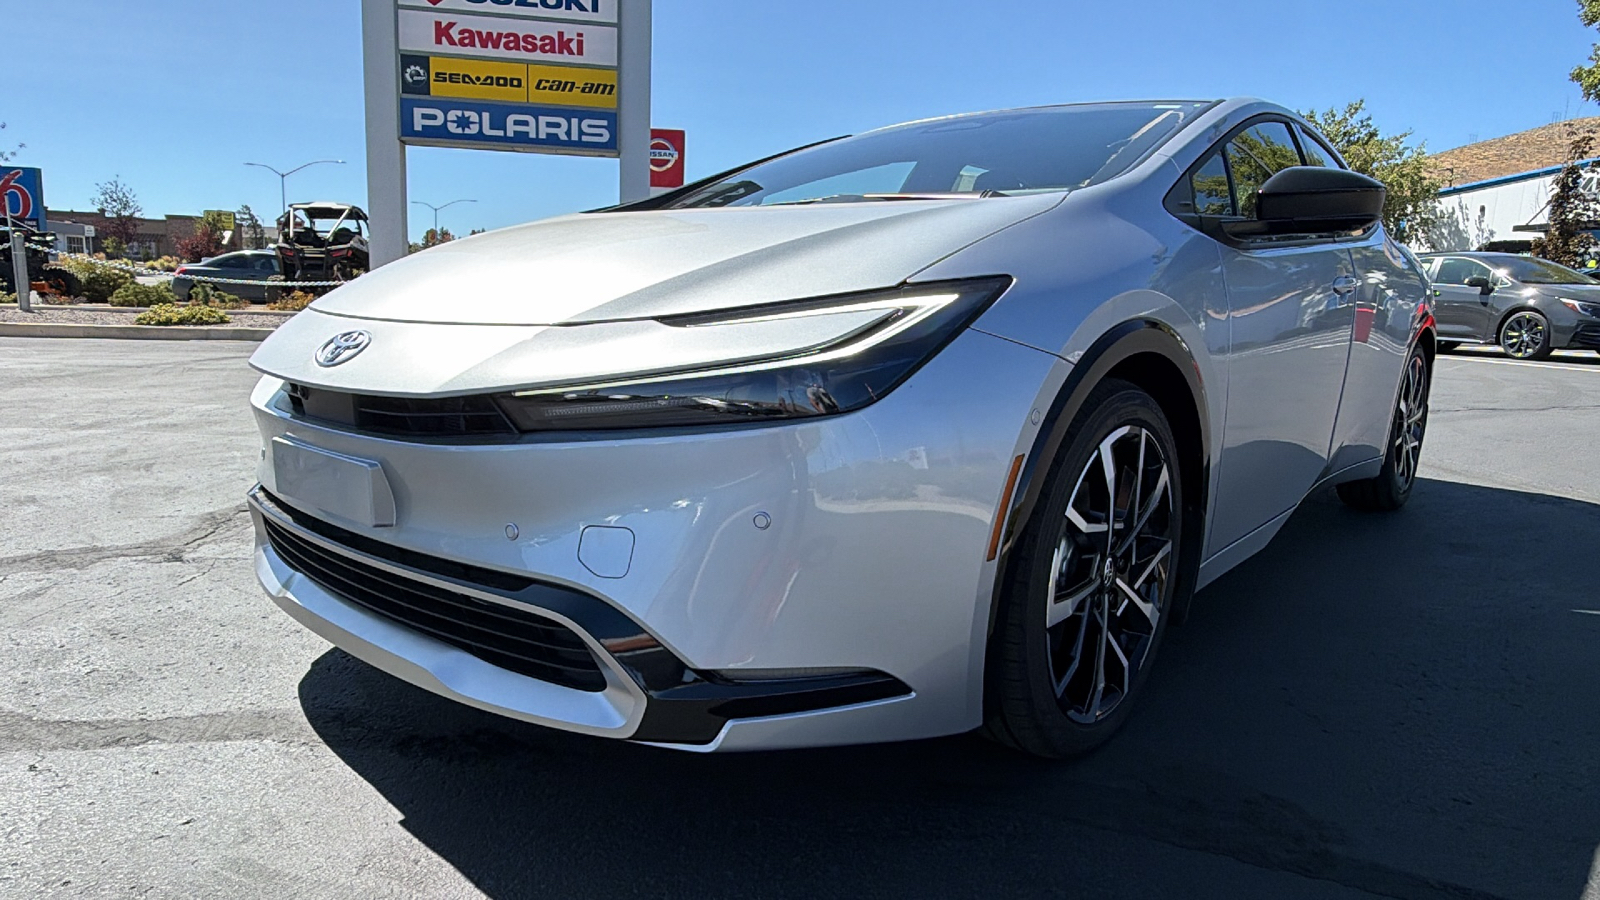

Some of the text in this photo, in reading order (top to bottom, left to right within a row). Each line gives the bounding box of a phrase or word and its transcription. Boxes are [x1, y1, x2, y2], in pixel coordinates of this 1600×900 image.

[434, 21, 584, 56] Kawasaki
[535, 79, 615, 95] can-am
[413, 107, 611, 143] POLARIS
[0, 170, 32, 219] 6
